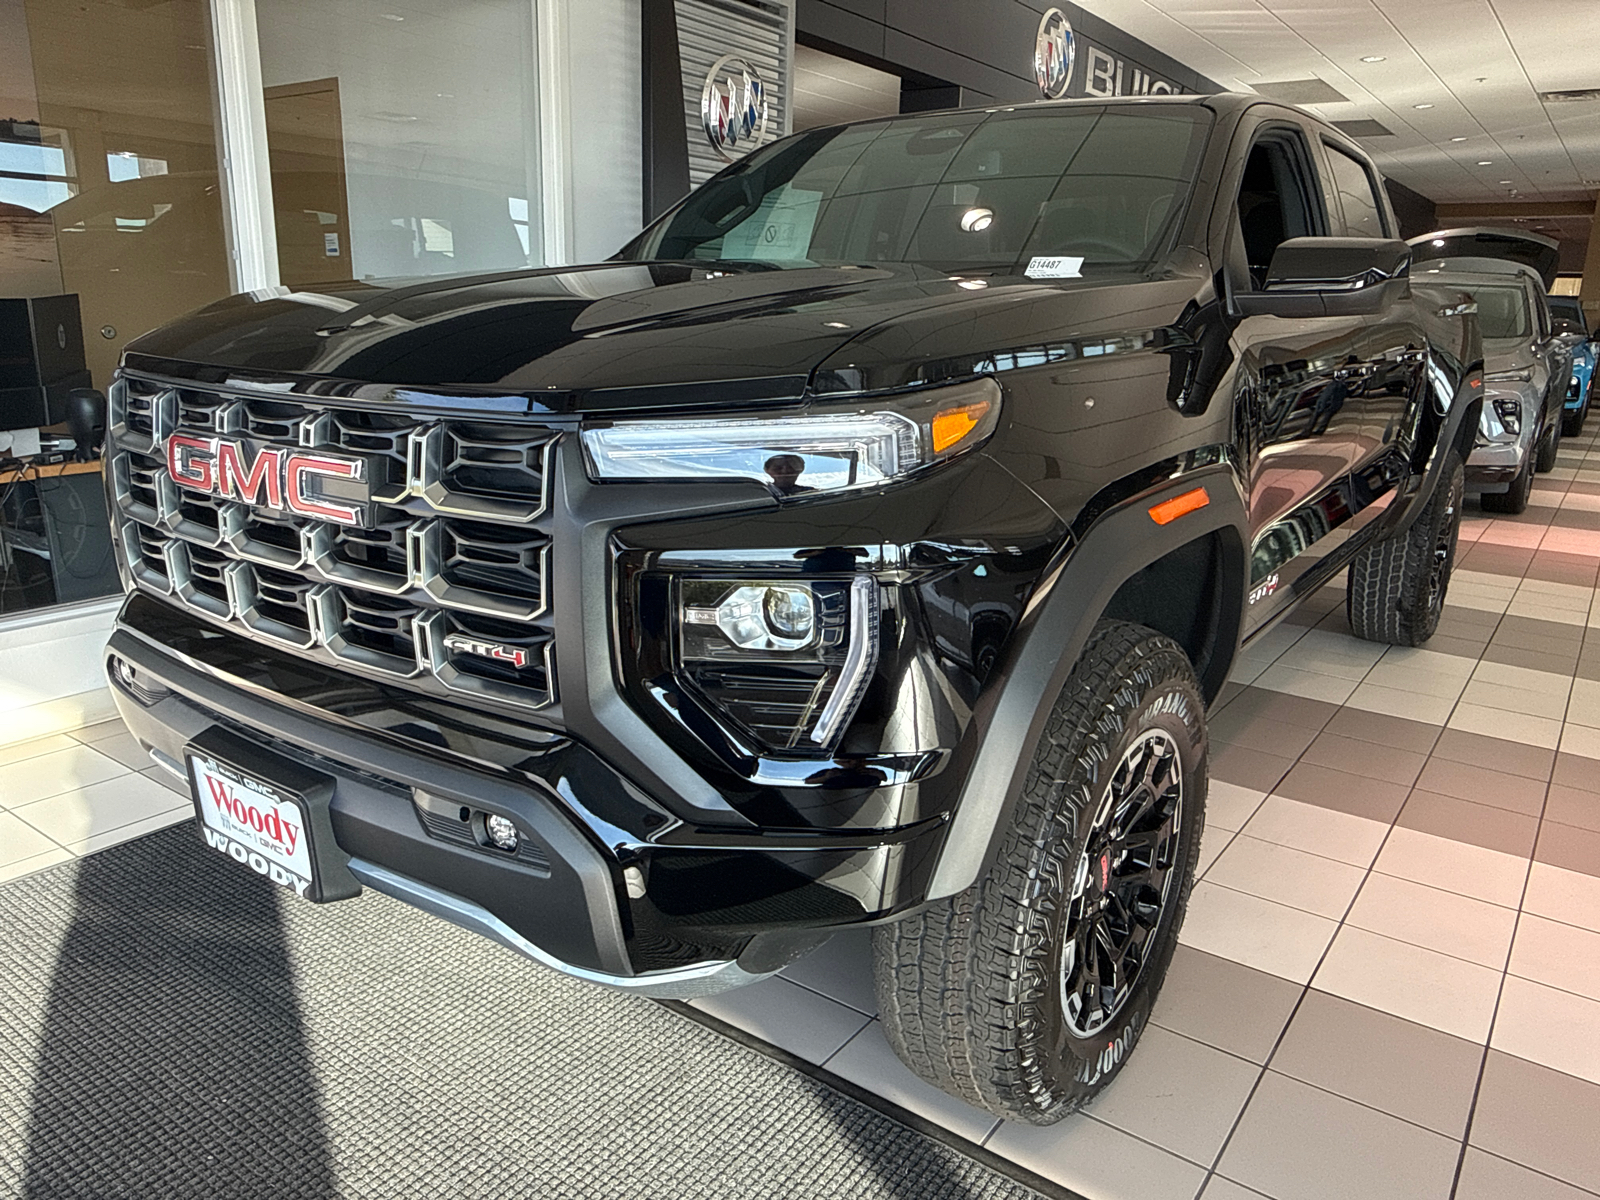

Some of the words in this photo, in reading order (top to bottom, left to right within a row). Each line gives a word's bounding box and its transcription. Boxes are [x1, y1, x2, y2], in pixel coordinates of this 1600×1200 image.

[1085, 45, 1180, 97] BUIC
[1029, 260, 1062, 269] G14487
[167, 433, 363, 528] GMC
[204, 774, 299, 856] Woody
[203, 827, 311, 897] WOODY
[258, 836, 284, 856] GMC
